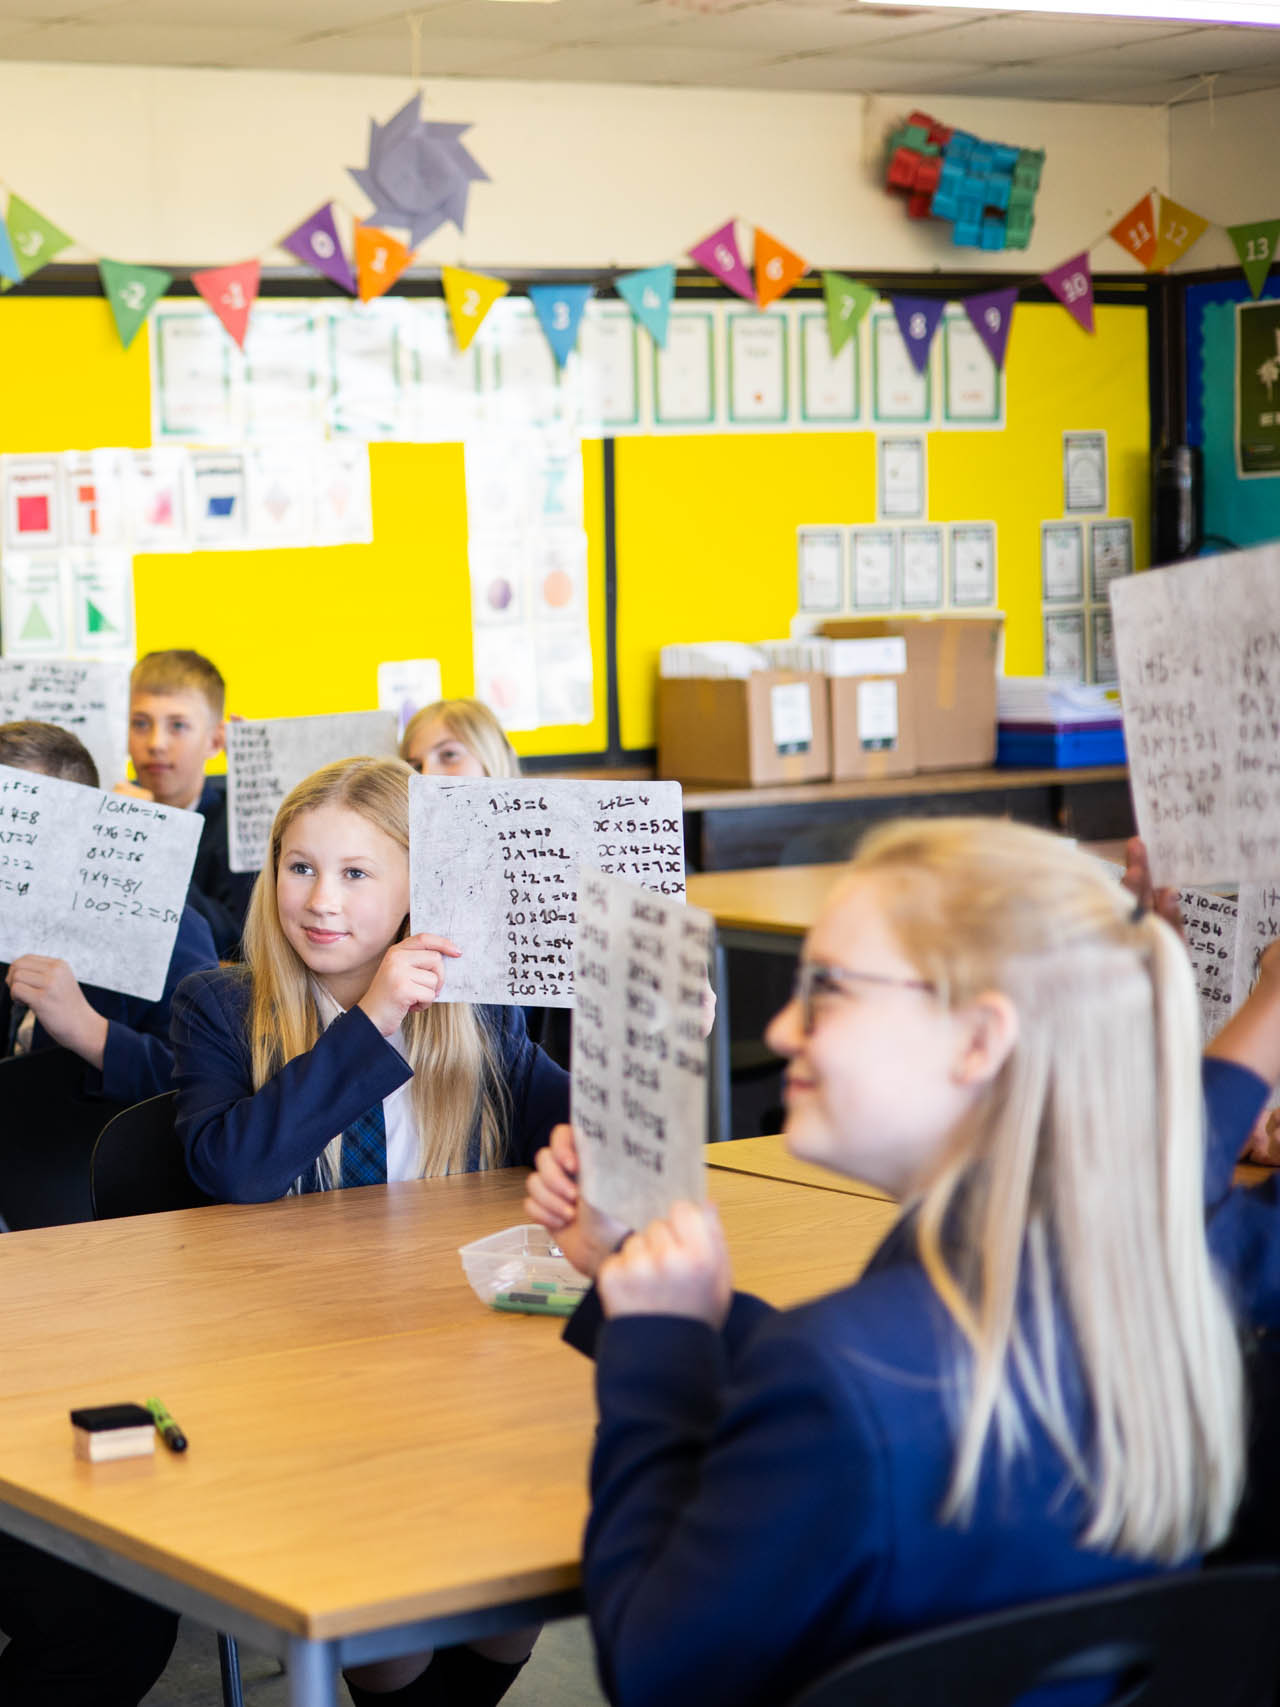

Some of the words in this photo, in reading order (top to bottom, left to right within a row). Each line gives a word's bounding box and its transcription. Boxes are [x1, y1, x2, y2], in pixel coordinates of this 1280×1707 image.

[1128, 223, 1151, 250] 11
[1165, 221, 1189, 247] 12
[714, 243, 736, 272] 5
[1245, 238, 1270, 263] 13
[766, 257, 783, 281] 6
[643, 286, 661, 309] 4
[1061, 274, 1089, 303] 10
[462, 289, 481, 317] 2
[838, 297, 855, 320] 7
[553, 302, 571, 331] 3
[910, 312, 926, 340] 8
[985, 307, 1002, 333] 9
